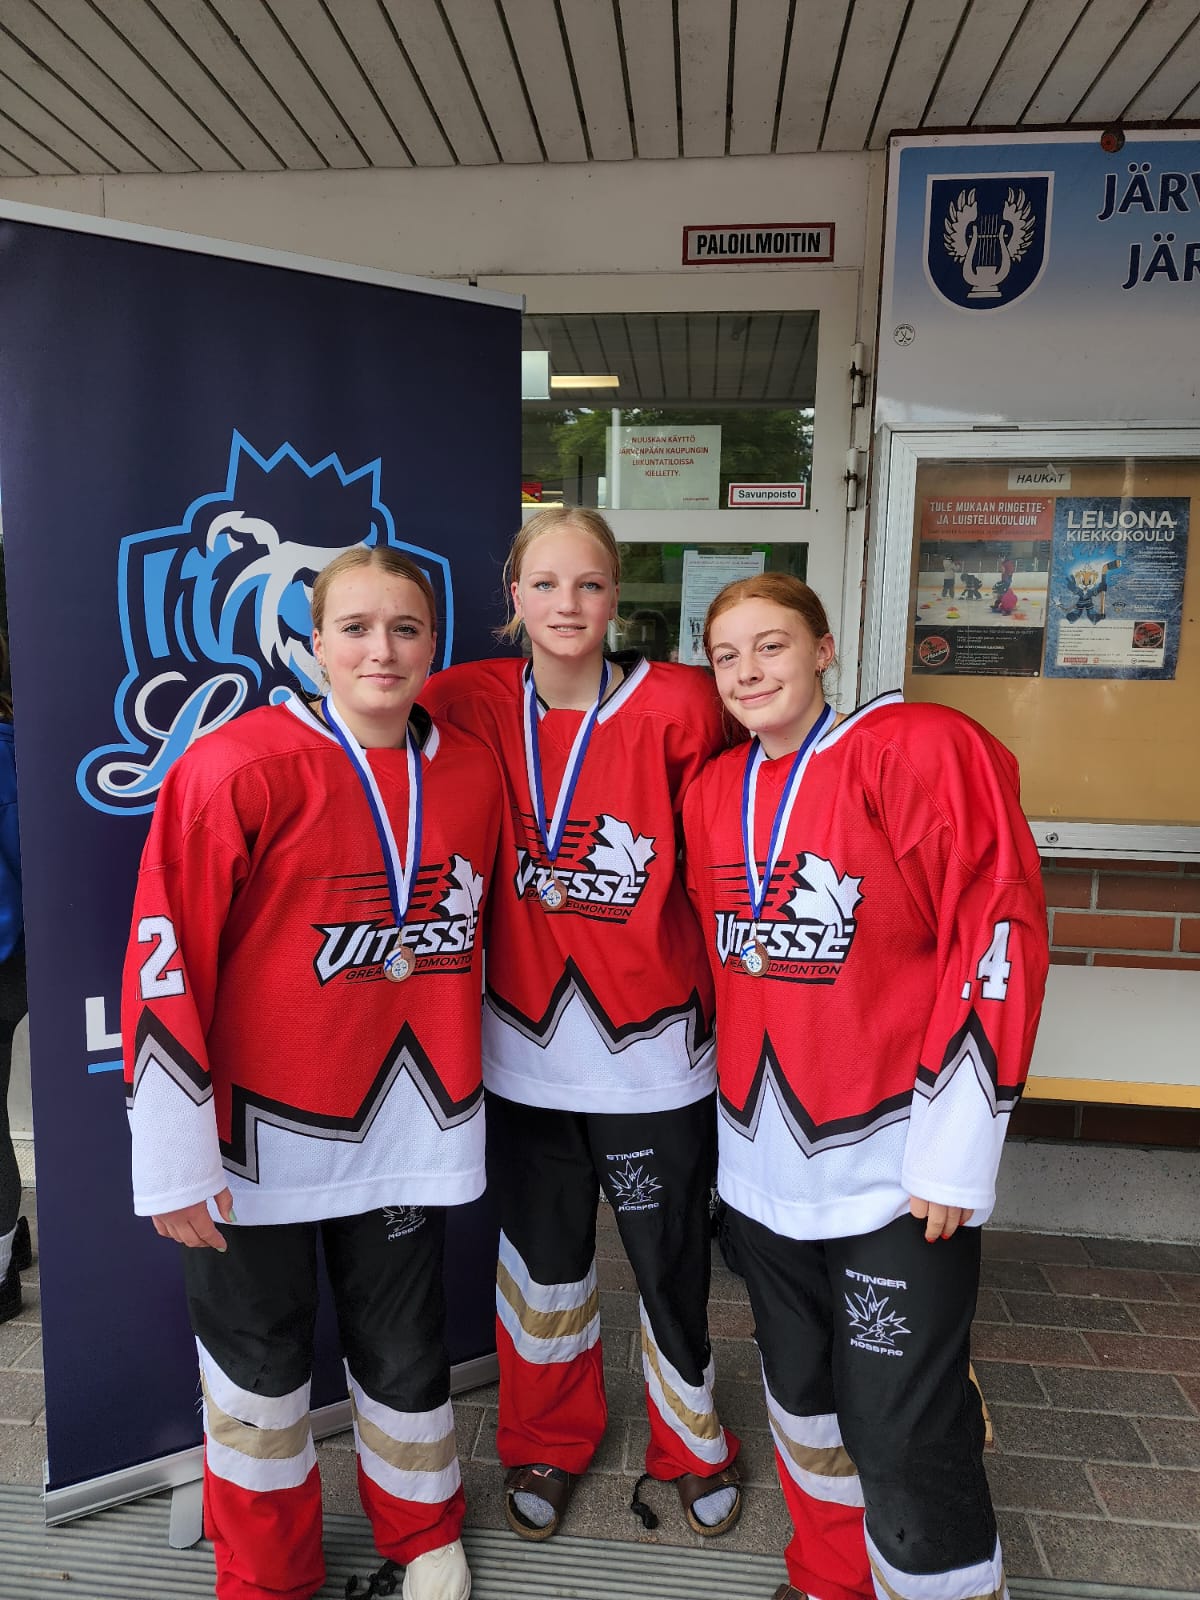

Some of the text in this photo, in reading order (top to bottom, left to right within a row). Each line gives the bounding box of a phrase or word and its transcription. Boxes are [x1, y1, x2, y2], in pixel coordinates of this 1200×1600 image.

[1096, 161, 1200, 221] JÄR
[696, 231, 821, 255] PALOILMOITIN
[669, 434, 696, 443] KÄYTTÖ
[666, 446, 709, 454] KAUPUNGIN
[632, 458, 695, 466] LIIKUNTATILOISSA
[1016, 473, 1065, 484] HAUKAT
[738, 489, 797, 500] Savunpoisto
[929, 501, 1046, 513] TULE MUKAAN RINGETTE-
[936, 514, 1038, 526] JA LUISTELUKOULUUN
[1067, 510, 1178, 529] LEIJONA
[1066, 530, 1175, 542] KIEKKOKOULU
[715, 912, 855, 964] VITESSE
[315, 916, 477, 983] VITESSE
[137, 914, 187, 1001] 2
[414, 954, 472, 968] EDMONTO
[768, 962, 842, 975] DMONTON
[606, 1148, 654, 1161] STINGER
[845, 1268, 908, 1290] STINGER
